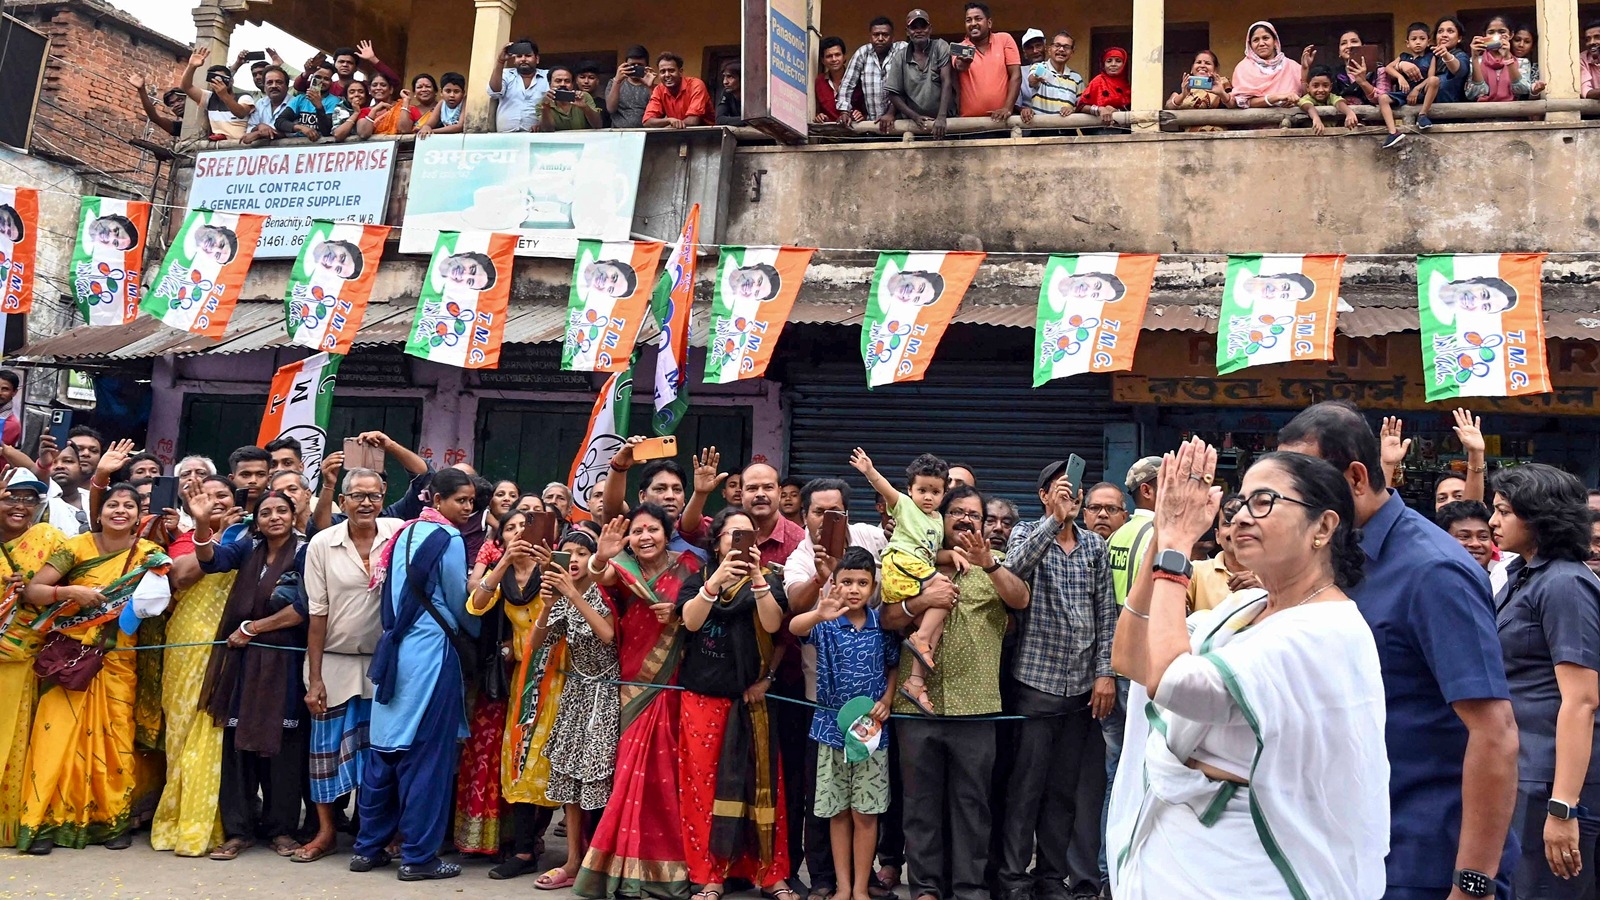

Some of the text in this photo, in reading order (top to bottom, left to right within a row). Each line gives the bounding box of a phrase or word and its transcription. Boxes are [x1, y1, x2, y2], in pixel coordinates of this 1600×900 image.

[772, 16, 805, 53] Panasonic
[772, 55, 806, 85] PROJECTOR
[774, 42, 805, 71] FAX & LCD
[196, 148, 389, 179] SREE DURGA ENTERPRISE
[210, 198, 261, 210] GENERAL
[264, 196, 304, 208] ORDER
[306, 194, 361, 207] SUPPLIER
[226, 180, 341, 195] CIVIL CONTRACTOR
